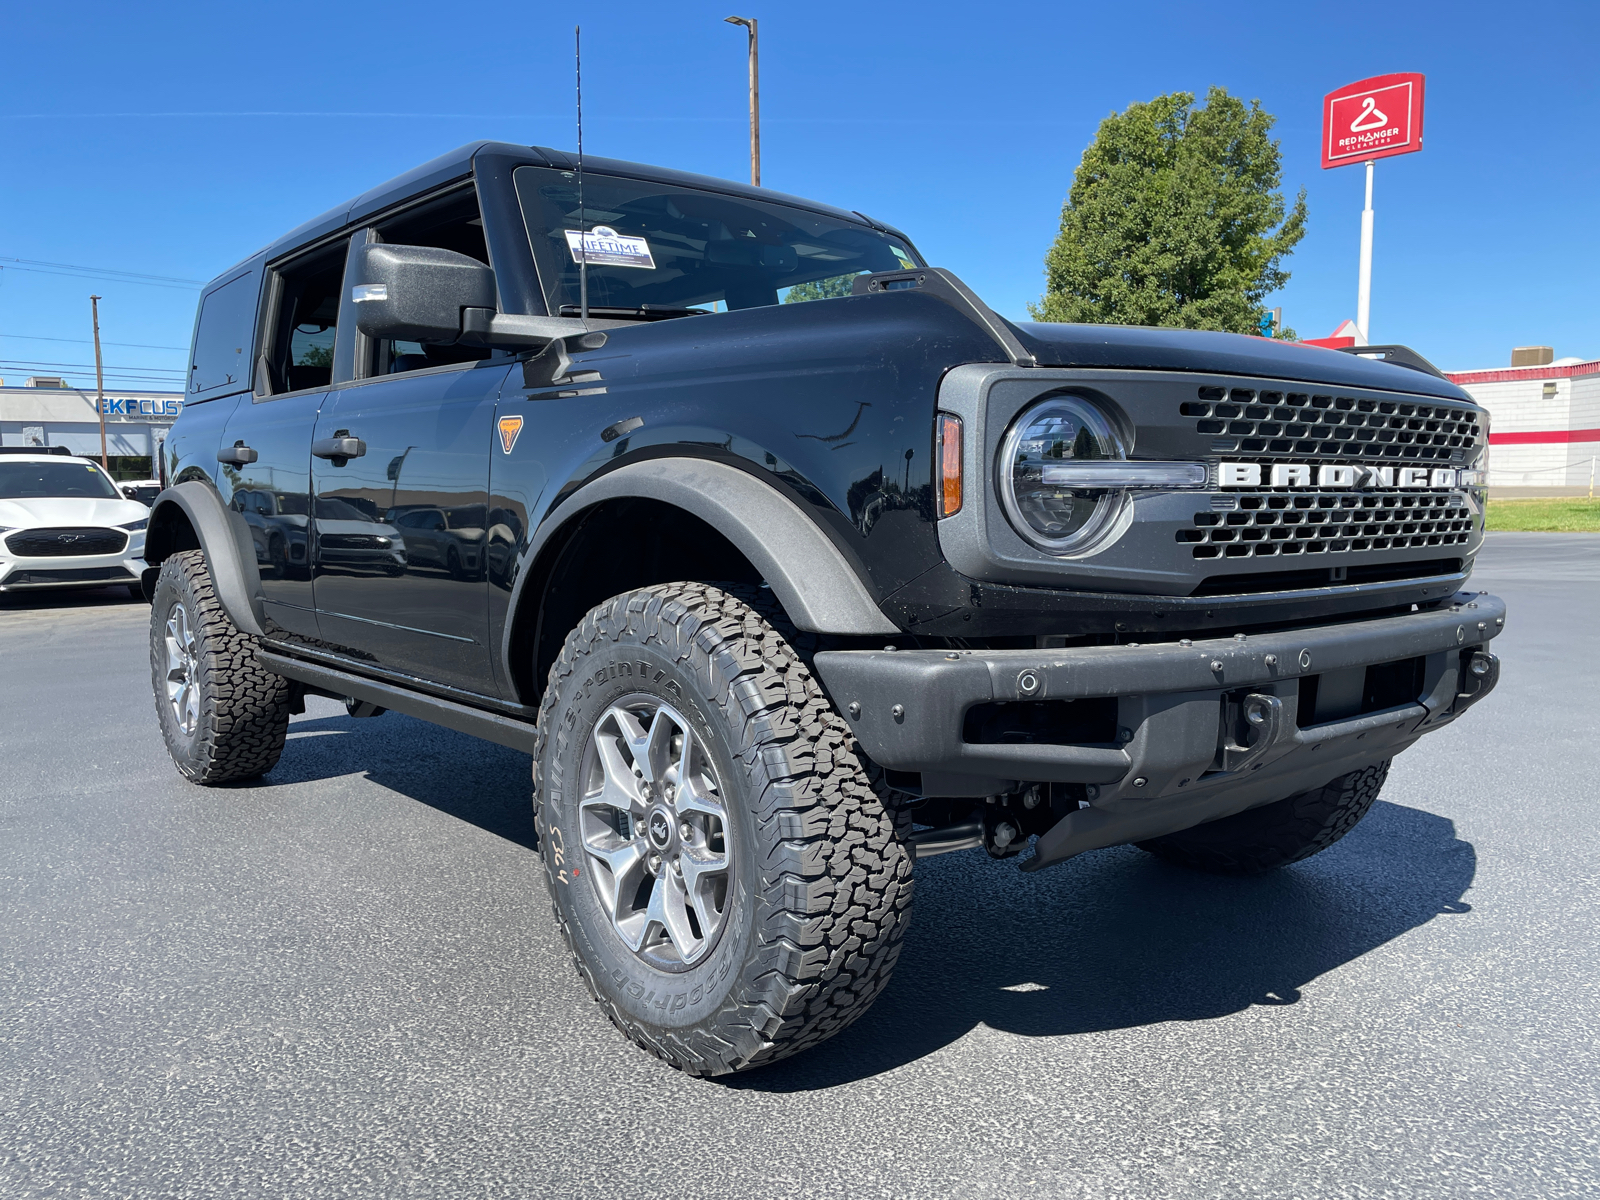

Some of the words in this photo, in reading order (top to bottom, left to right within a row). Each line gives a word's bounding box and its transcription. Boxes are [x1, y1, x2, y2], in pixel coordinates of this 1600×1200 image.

[1339, 136, 1357, 147] RED
[1346, 137, 1391, 151] CLEANERS
[1218, 462, 1456, 488] BRONCO
